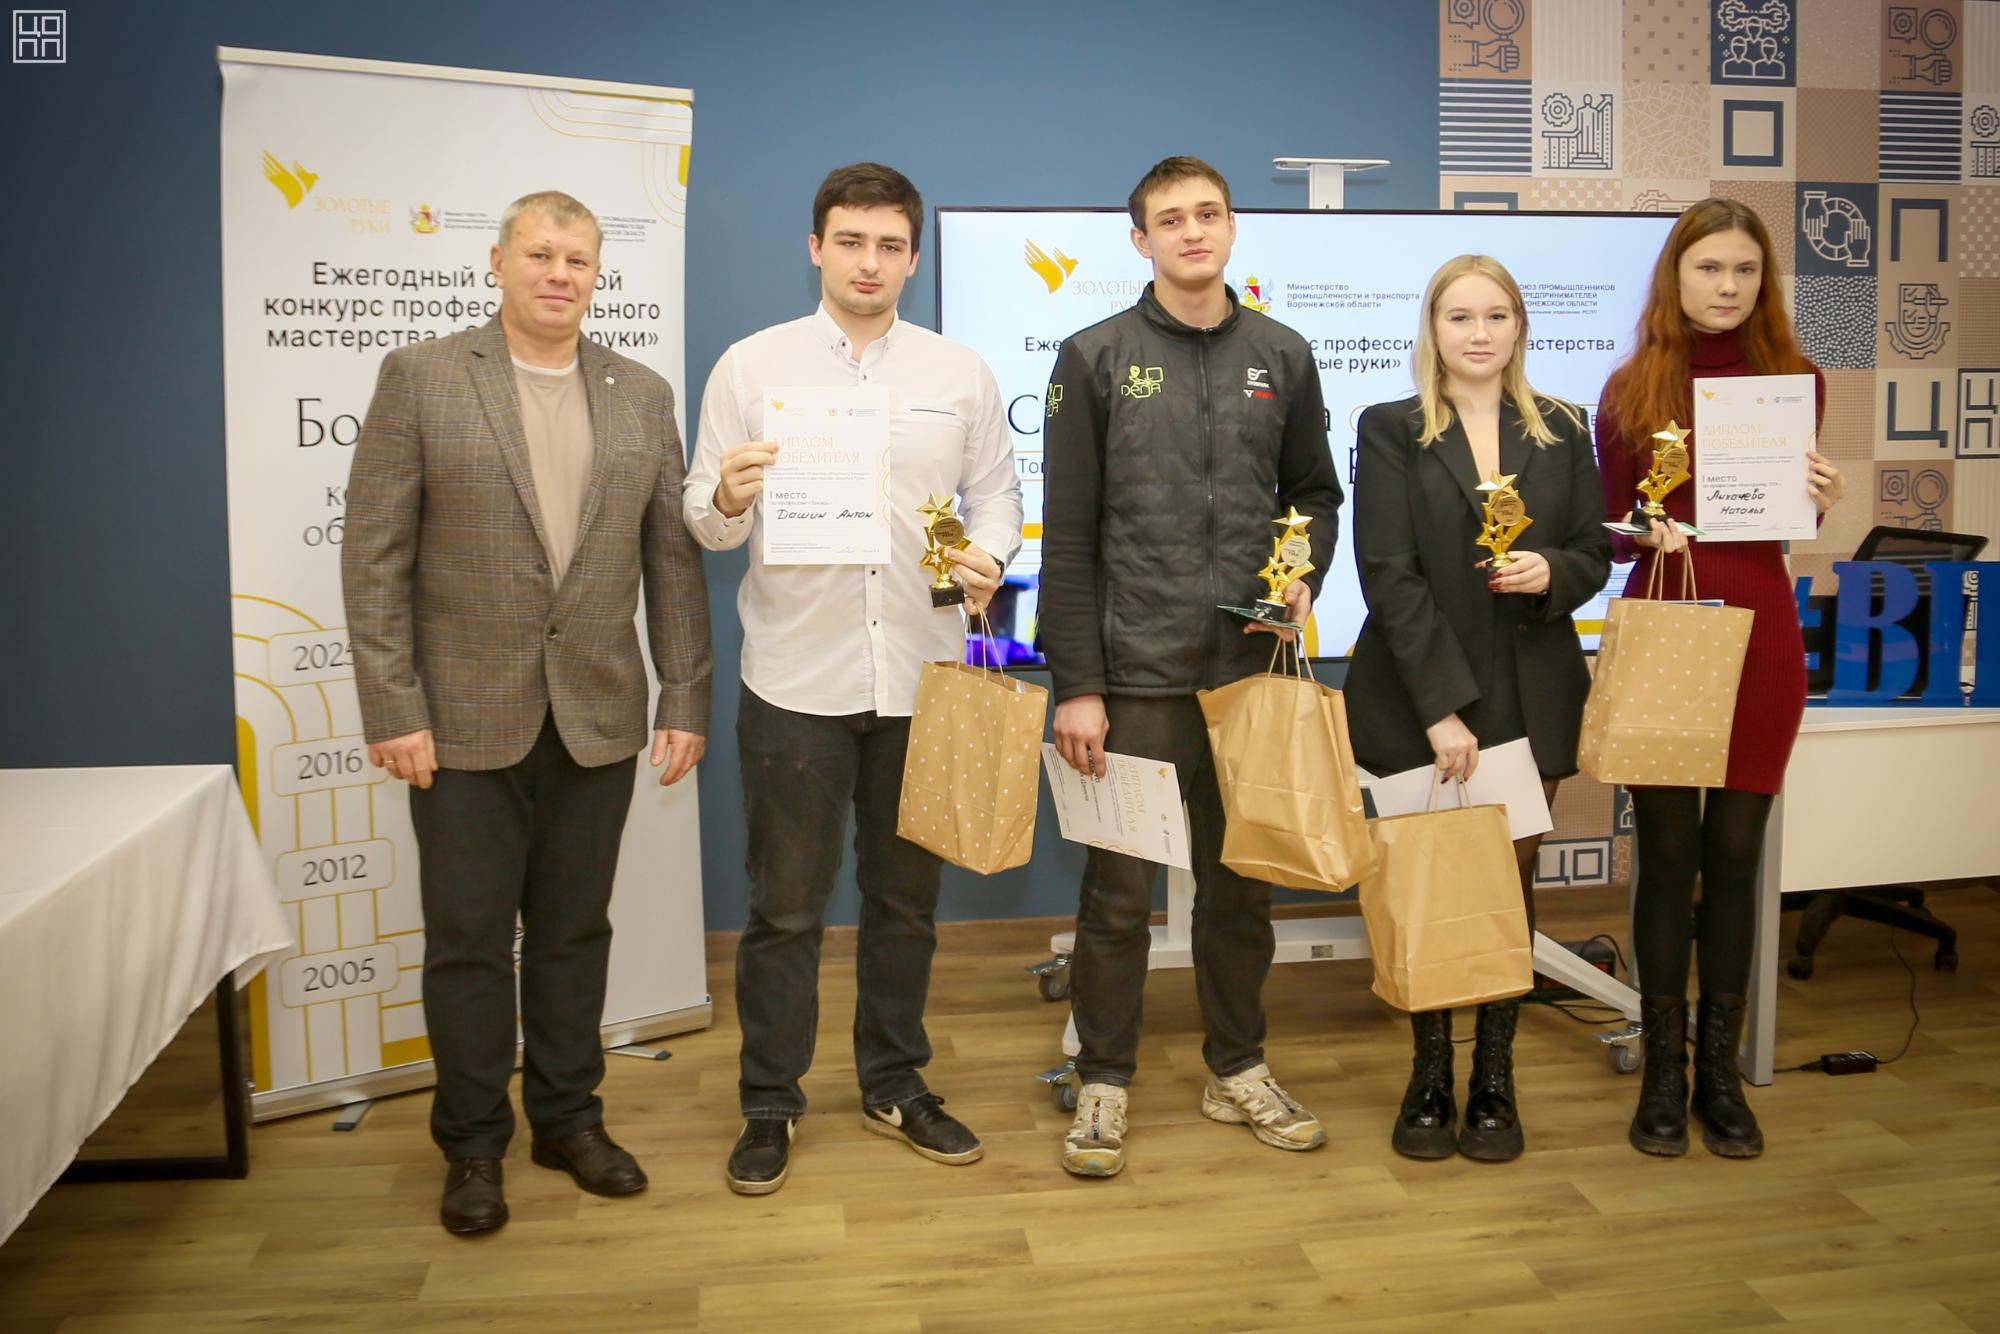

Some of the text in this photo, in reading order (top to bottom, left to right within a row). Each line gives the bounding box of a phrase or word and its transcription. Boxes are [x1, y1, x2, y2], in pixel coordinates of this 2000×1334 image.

[312, 197, 392, 214] ЗОЛОТЫЕ
[351, 218, 391, 235] РУКИ
[313, 262, 475, 292] Ежегодный
[1287, 283, 1349, 292] Министерство
[1287, 292, 1362, 300] промышленности
[1372, 293, 1420, 301] транспорта
[264, 297, 384, 323] конкурс
[1287, 301, 1345, 309] Воронежской
[267, 328, 436, 352] мастерства
[1527, 339, 1615, 354] астерства
[1349, 357, 1401, 373] руки»
[1703, 423, 1761, 435] ДИПЛОМ
[775, 436, 833, 448] ИПЛОМ
[1702, 436, 1787, 449] ПОБЕДИТЕЛЯ
[1708, 475, 1738, 483] место
[775, 492, 808, 500] место
[1720, 505, 1766, 515] Наталья
[298, 748, 364, 780] 2016
[302, 854, 367, 886] 2012
[302, 957, 376, 992] 2005
